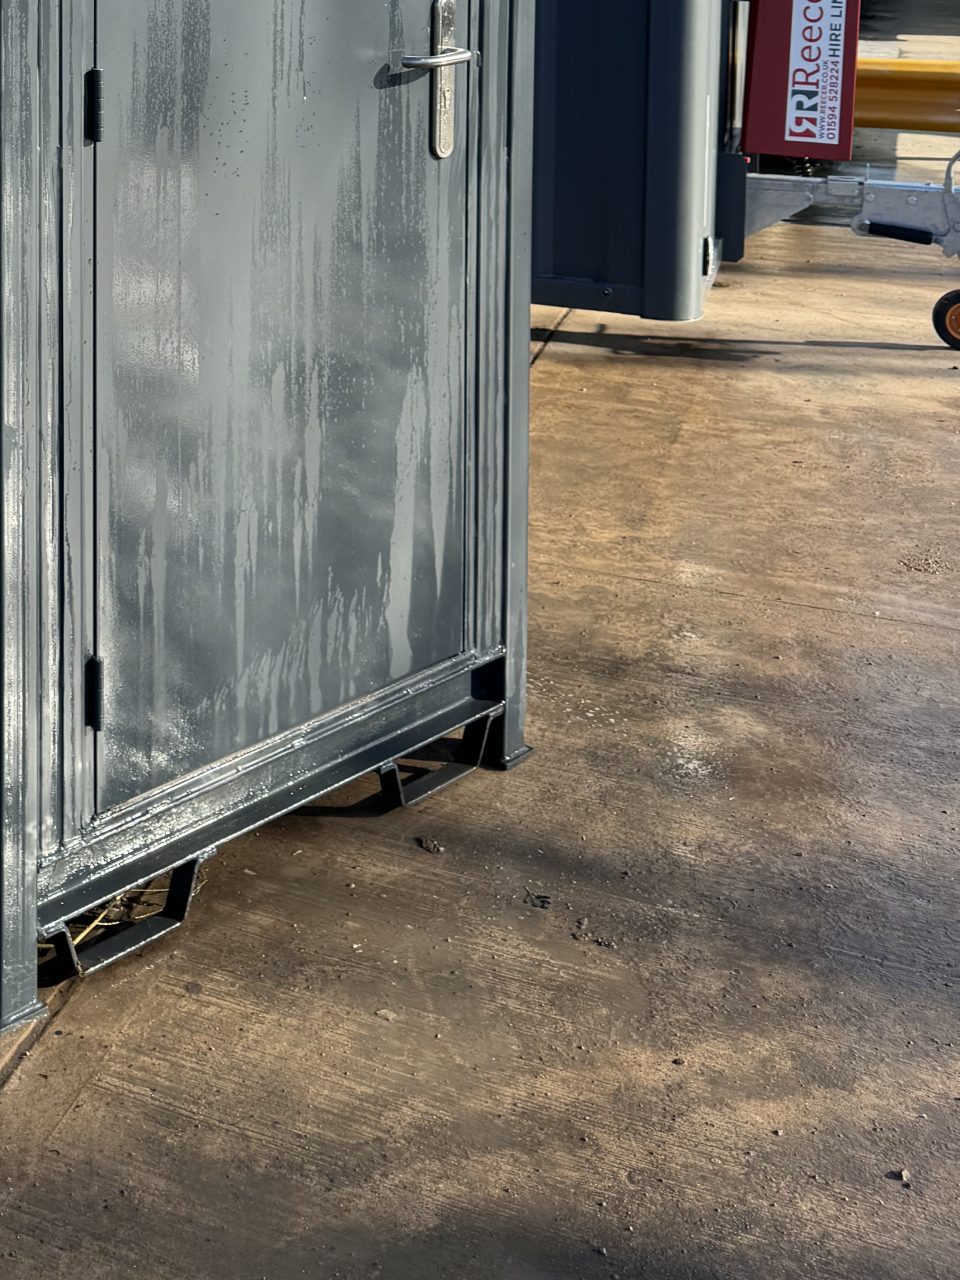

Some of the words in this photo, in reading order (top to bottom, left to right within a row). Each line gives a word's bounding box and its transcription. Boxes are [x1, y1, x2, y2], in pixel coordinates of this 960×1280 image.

[828, 22, 842, 58] HIRE
[828, 60, 840, 102] 528224
[826, 106, 837, 140] 01594
